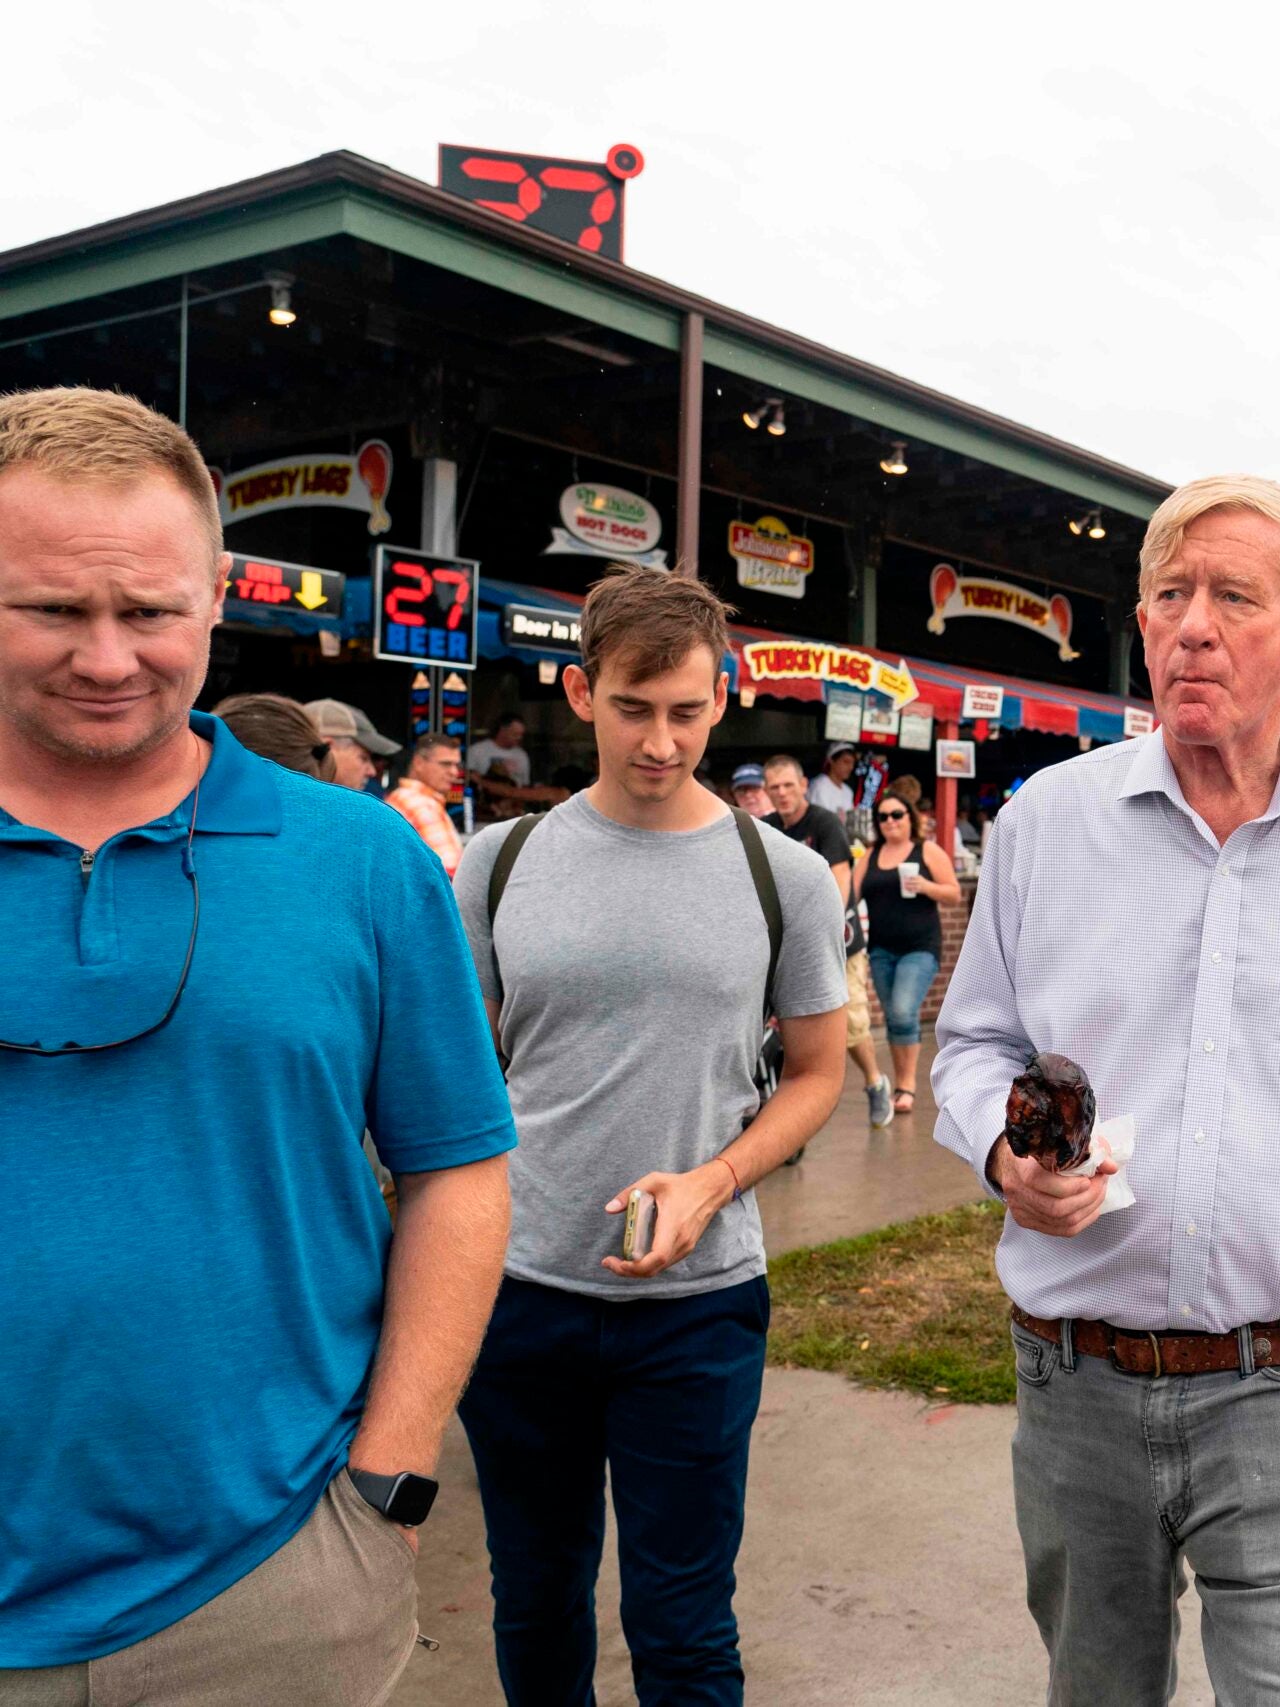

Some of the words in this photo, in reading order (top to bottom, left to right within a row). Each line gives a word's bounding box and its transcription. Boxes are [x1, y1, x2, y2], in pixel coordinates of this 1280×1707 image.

[576, 515, 607, 531] HOT
[610, 522, 648, 541] DOGS
[235, 578, 292, 604] TAP
[384, 561, 470, 631] 27
[386, 621, 468, 661] BEER
[750, 647, 825, 675] TURKEY
[828, 651, 872, 685] LEGS
